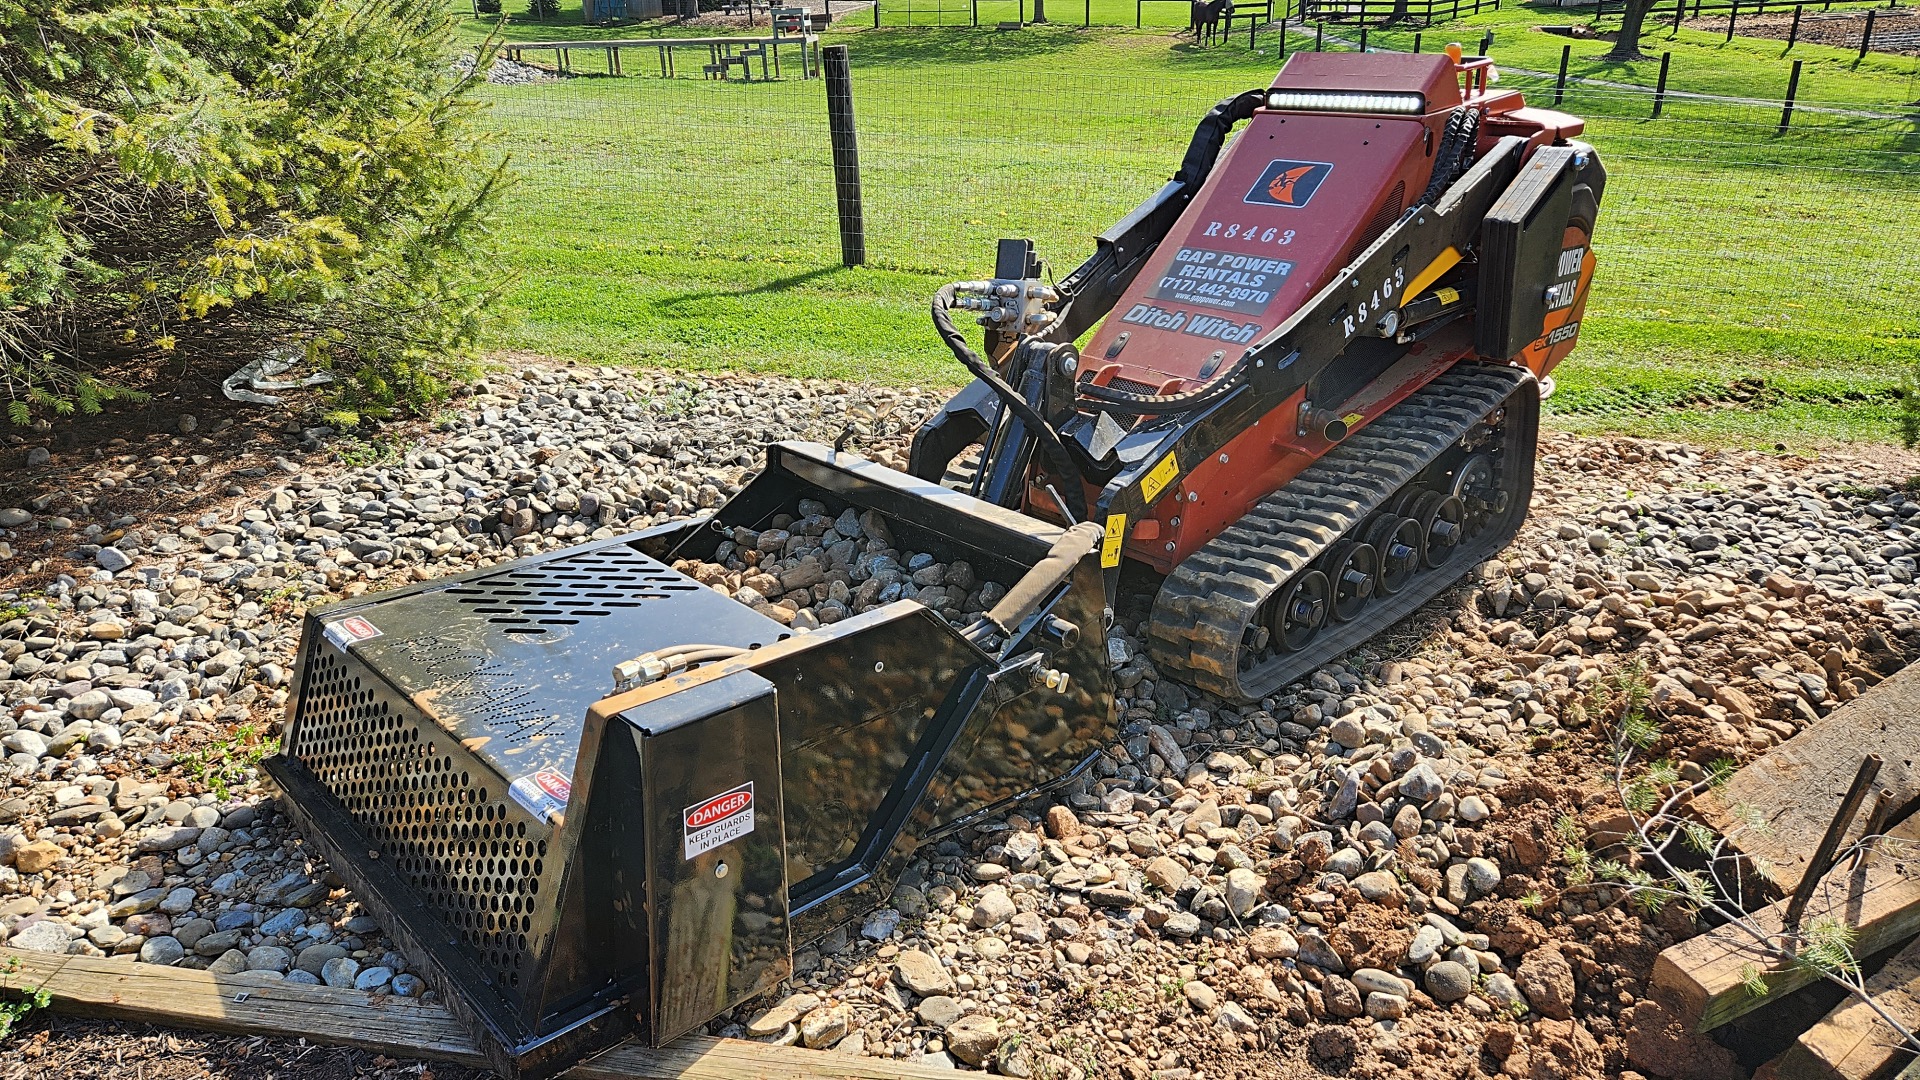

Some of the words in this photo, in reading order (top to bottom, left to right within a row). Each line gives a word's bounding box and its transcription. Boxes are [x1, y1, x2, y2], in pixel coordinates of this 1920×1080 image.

[1203, 221, 1296, 245] R8463
[1176, 249, 1216, 264] GAP
[1217, 254, 1292, 276] POWER
[1179, 264, 1266, 287] RENTALS
[1558, 247, 1584, 277] OWER
[1159, 276, 1197, 292] (717)
[1196, 282, 1270, 304] 442-8970
[1174, 292, 1236, 307] www.gappower.com
[1343, 266, 1404, 338] R8463
[1122, 306, 1184, 330] Ditch
[1185, 315, 1260, 343] Witch
[1534, 337, 1548, 350] SK
[1548, 322, 1579, 345] 1550
[693, 794, 745, 825] DANGER
[688, 829, 712, 846] KEEP
[714, 812, 751, 834] GUARDS
[700, 841, 710, 850] IN
[712, 827, 741, 845] PLACE
